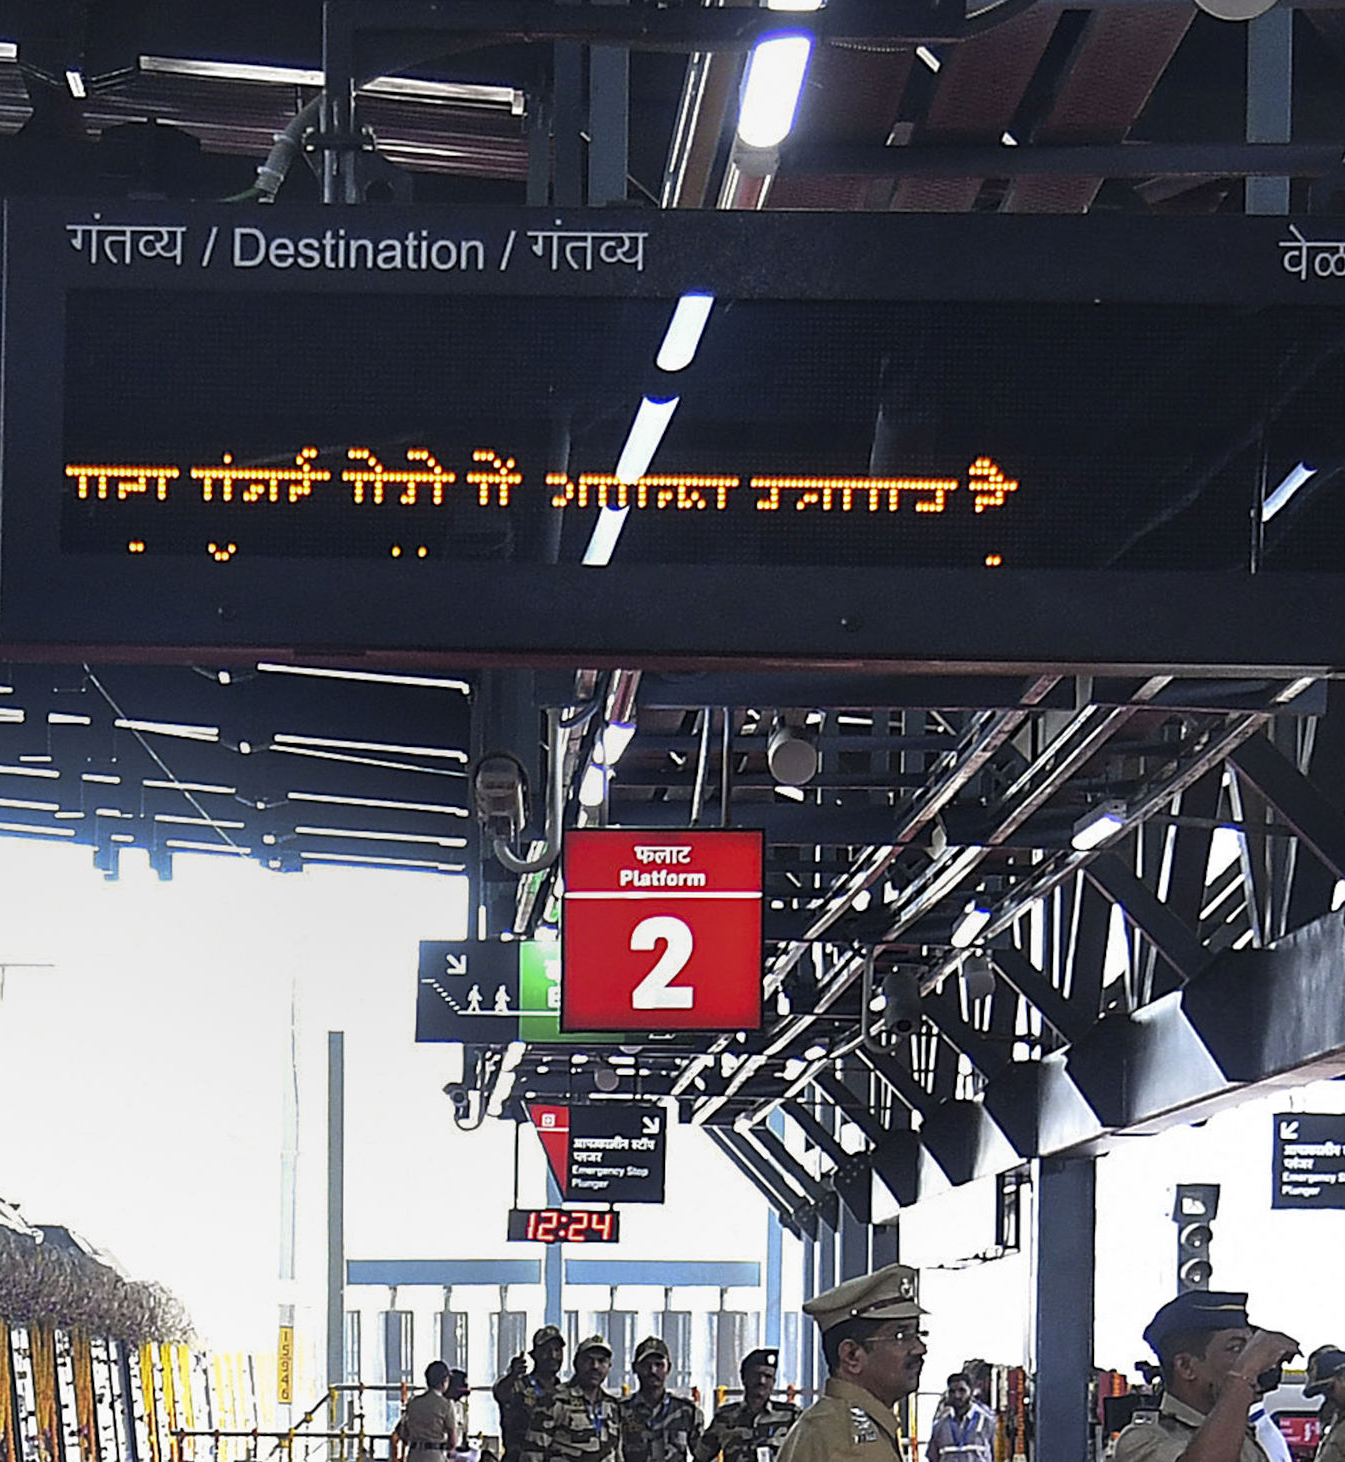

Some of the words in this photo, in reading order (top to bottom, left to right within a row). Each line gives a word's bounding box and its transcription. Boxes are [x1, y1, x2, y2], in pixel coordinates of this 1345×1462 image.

[66, 213, 187, 266] गंतव्य
[201, 227, 218, 268] /
[233, 227, 485, 271] Destination
[499, 230, 516, 272] /
[527, 218, 649, 272] गंतव्य
[633, 846, 693, 865] फलाट
[619, 869, 707, 887] Platform
[630, 915, 694, 1010] 2
[527, 1211, 613, 1241] 12:24
